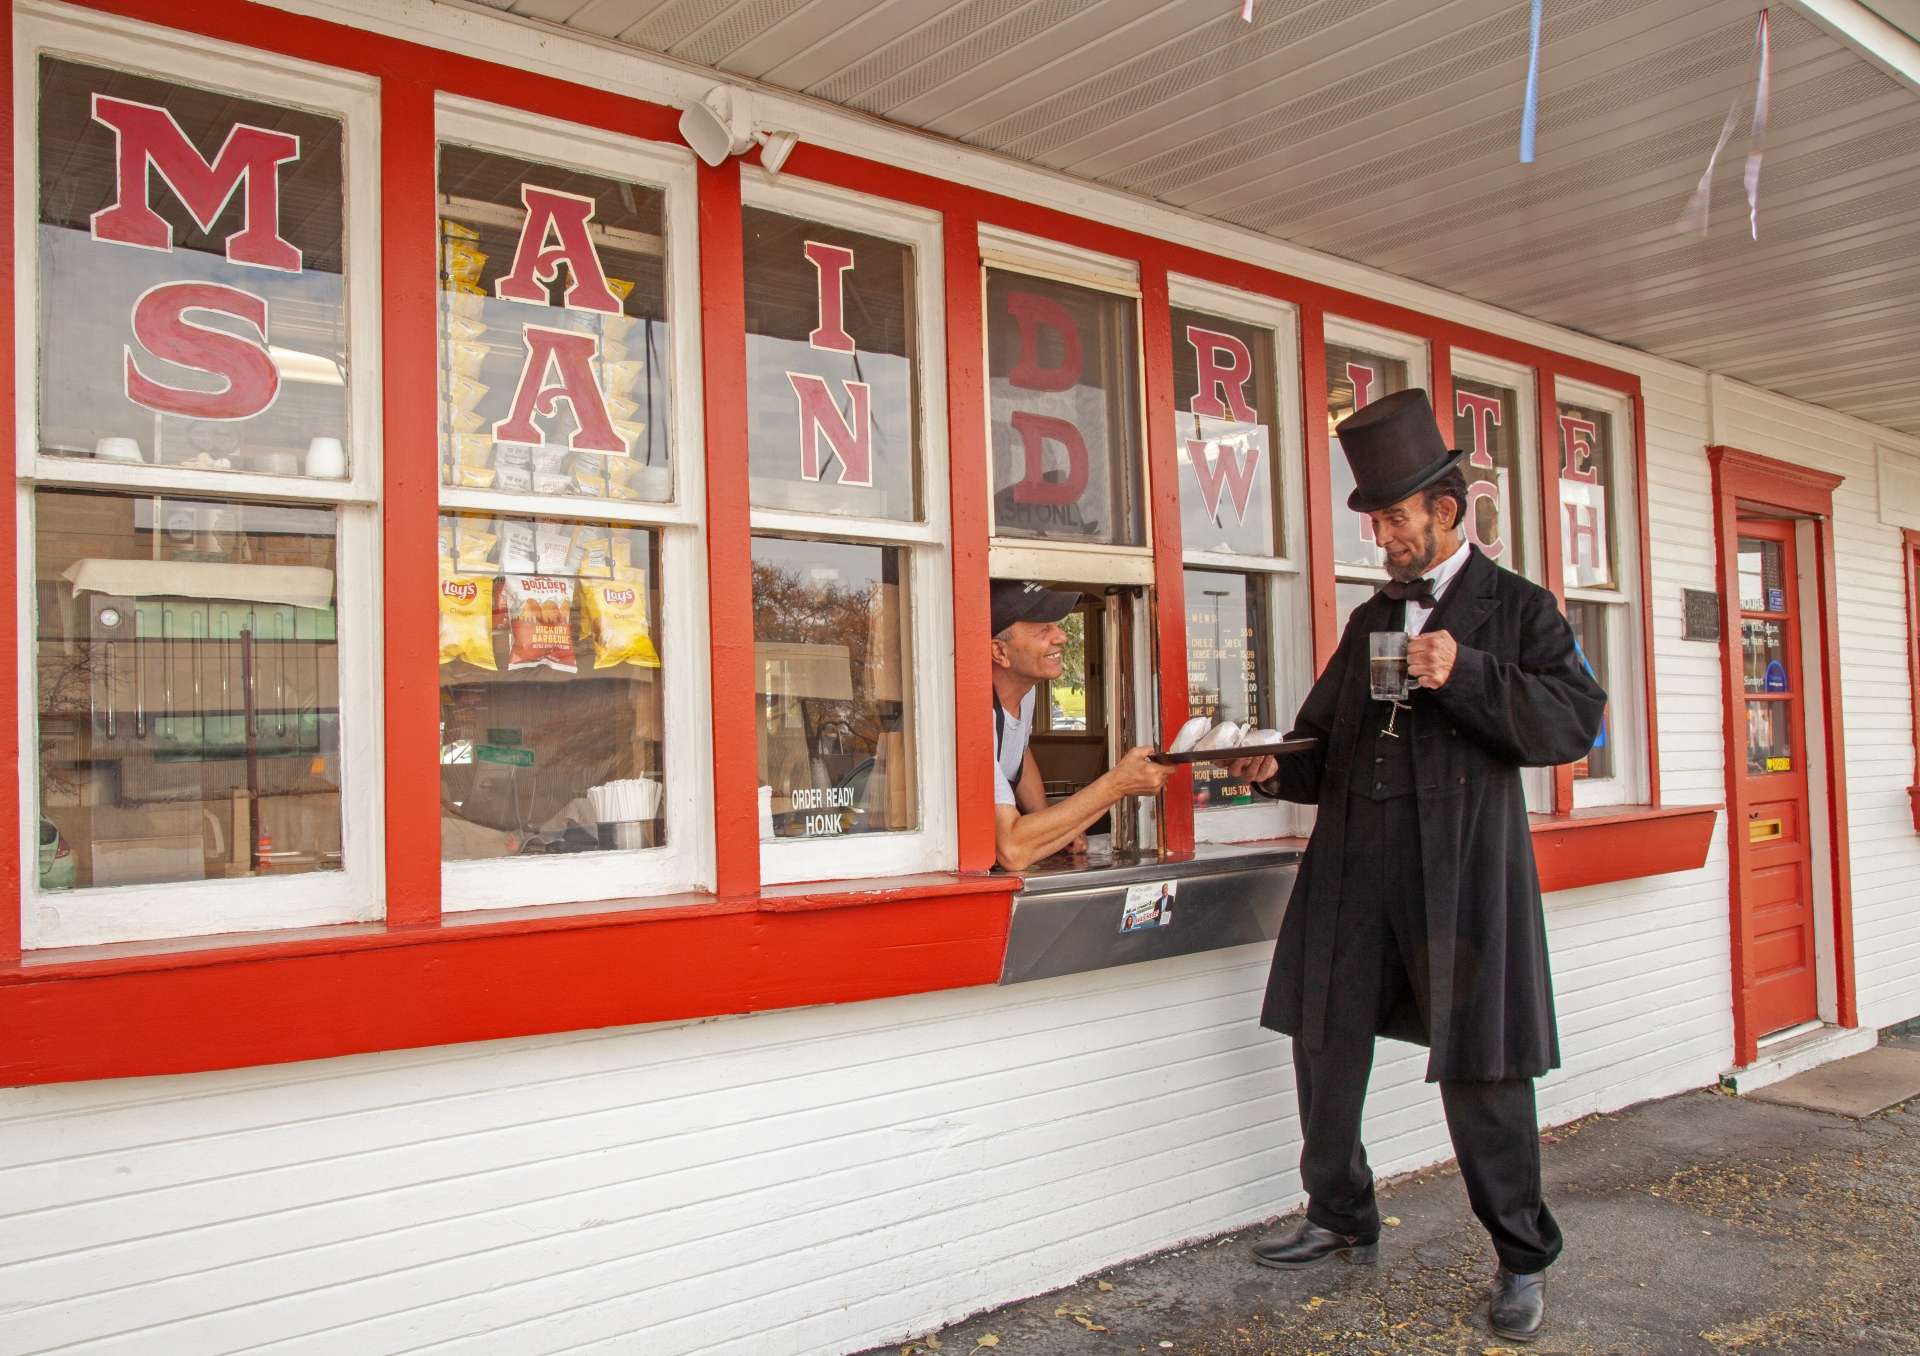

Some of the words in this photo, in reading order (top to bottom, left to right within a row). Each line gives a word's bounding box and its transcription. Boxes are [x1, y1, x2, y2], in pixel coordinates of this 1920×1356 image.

[441, 580, 477, 600] Lay's
[521, 579, 567, 595] BOULDER
[604, 587, 634, 604] Lay's
[792, 788, 822, 810] ORDER
[826, 787, 854, 807] READY
[1221, 786, 1237, 796] PLUS
[806, 813, 843, 835] HONK
